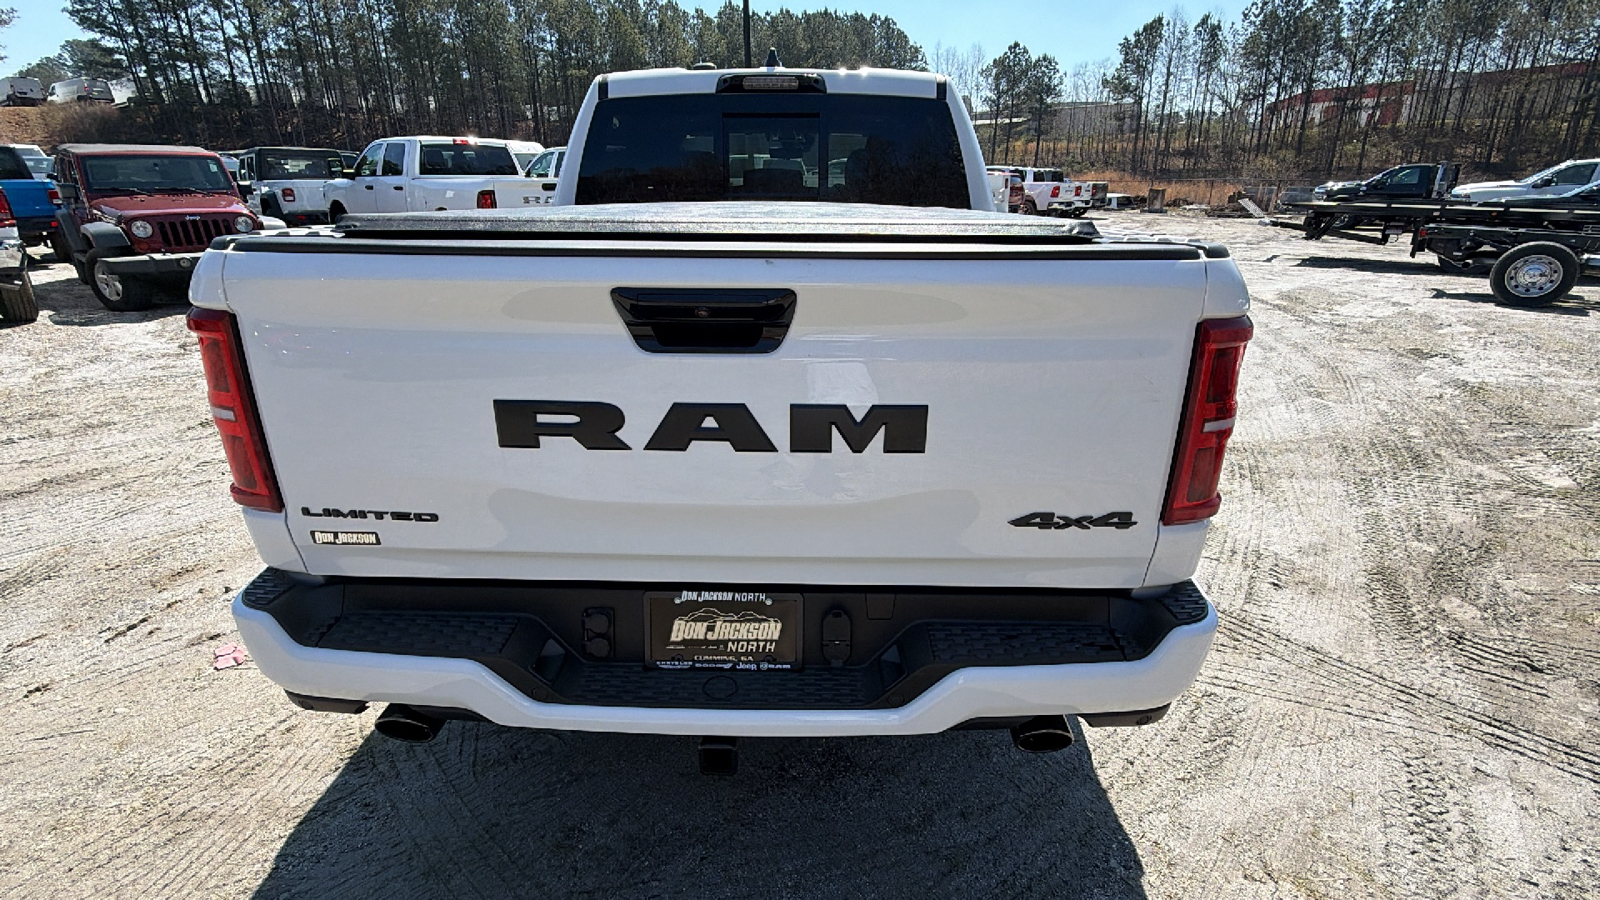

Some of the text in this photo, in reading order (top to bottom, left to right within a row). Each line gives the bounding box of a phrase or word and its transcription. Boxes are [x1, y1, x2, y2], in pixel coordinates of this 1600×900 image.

[493, 399, 928, 453] RAM
[301, 507, 439, 522] LIMITED
[1007, 512, 1138, 529] 4x4
[734, 592, 766, 602] NORTH
[727, 641, 776, 653] NORTH
